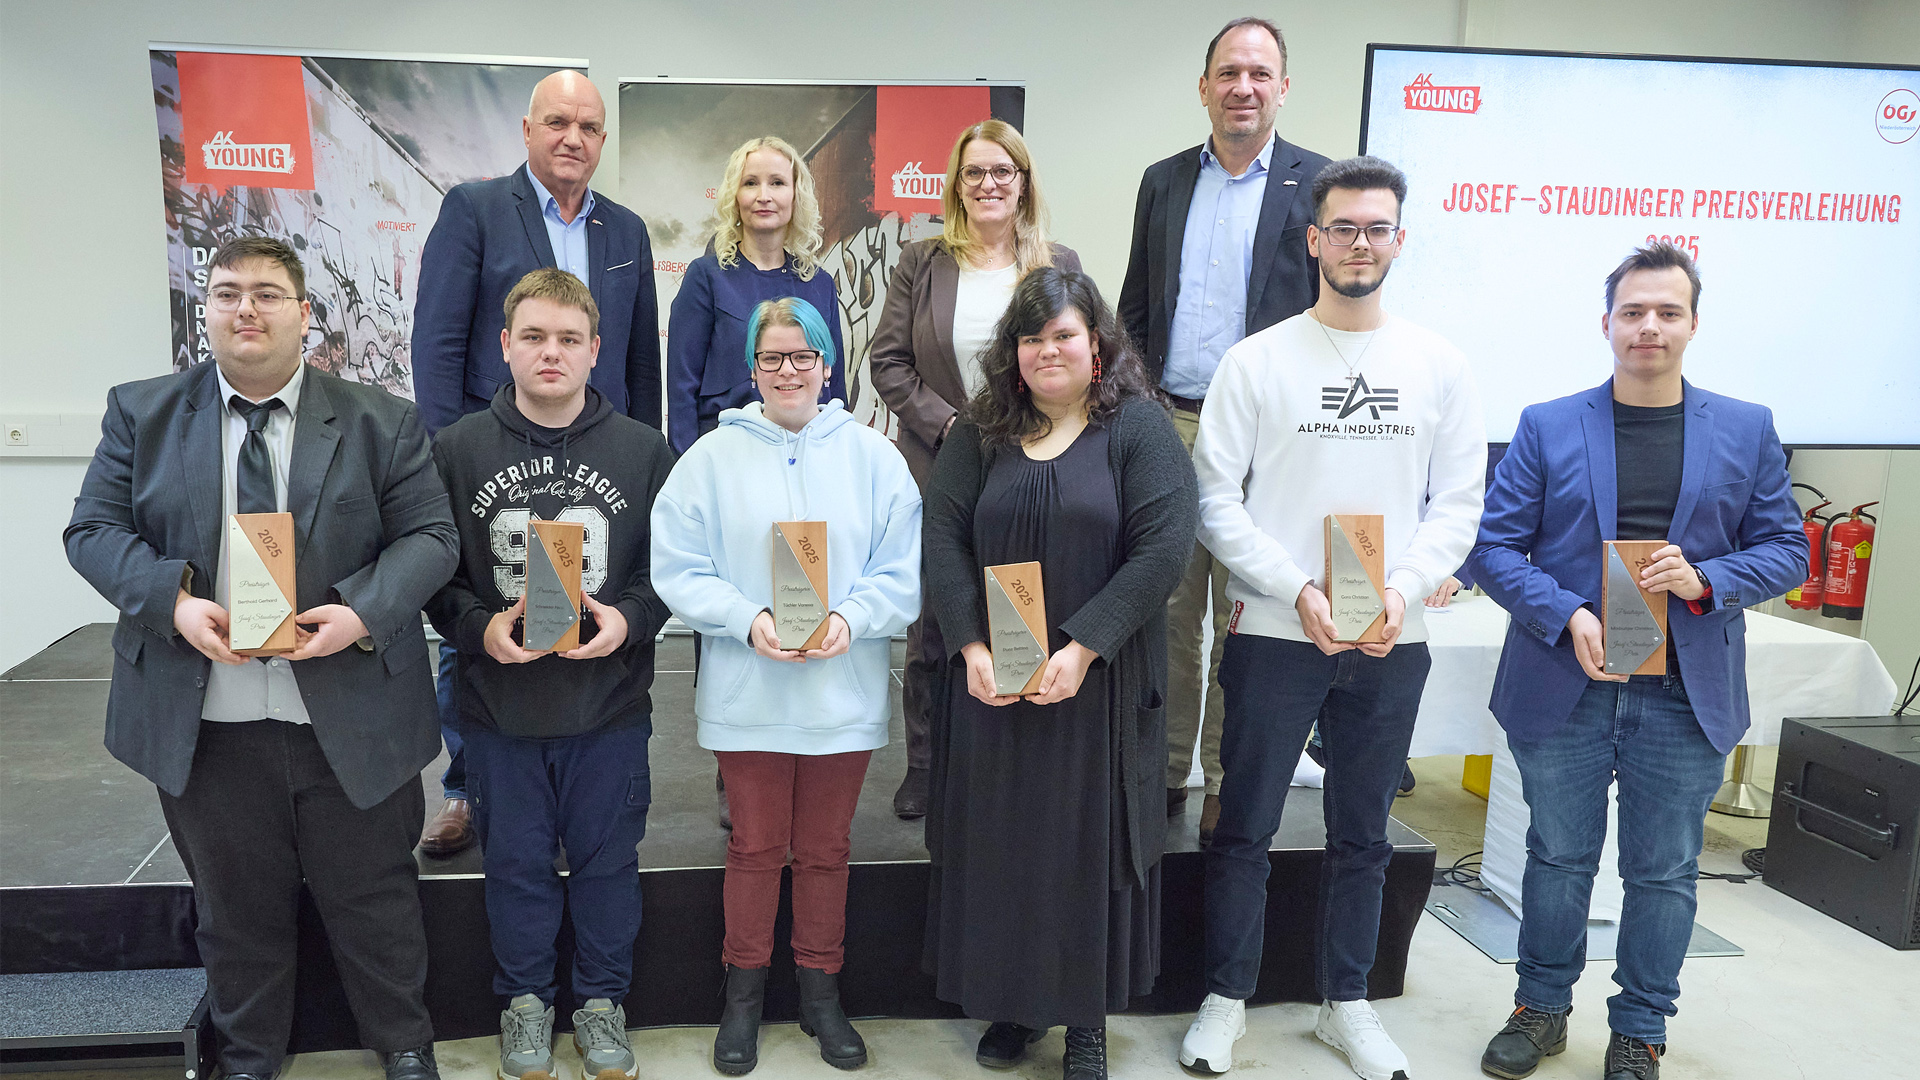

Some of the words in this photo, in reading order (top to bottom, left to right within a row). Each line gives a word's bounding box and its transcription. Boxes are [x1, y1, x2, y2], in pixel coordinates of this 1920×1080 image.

[1410, 73, 1434, 87] AK
[1409, 89, 1475, 111] YOUNG
[210, 130, 236, 146] AK
[209, 147, 285, 169] YOUNG
[900, 161, 924, 175] AK
[899, 177, 946, 196] YOUN
[1692, 189, 1902, 223] PREISVERLEIHUNG
[1297, 423, 1340, 433] ALPHA
[1344, 424, 1416, 436] INDUSTRIES
[471, 456, 554, 518] SUPERIOR
[257, 529, 283, 558] 2025
[552, 539, 574, 568] 2025
[797, 536, 820, 564] 2025
[1354, 529, 1377, 557] 2025
[1010, 578, 1034, 607] 2025
